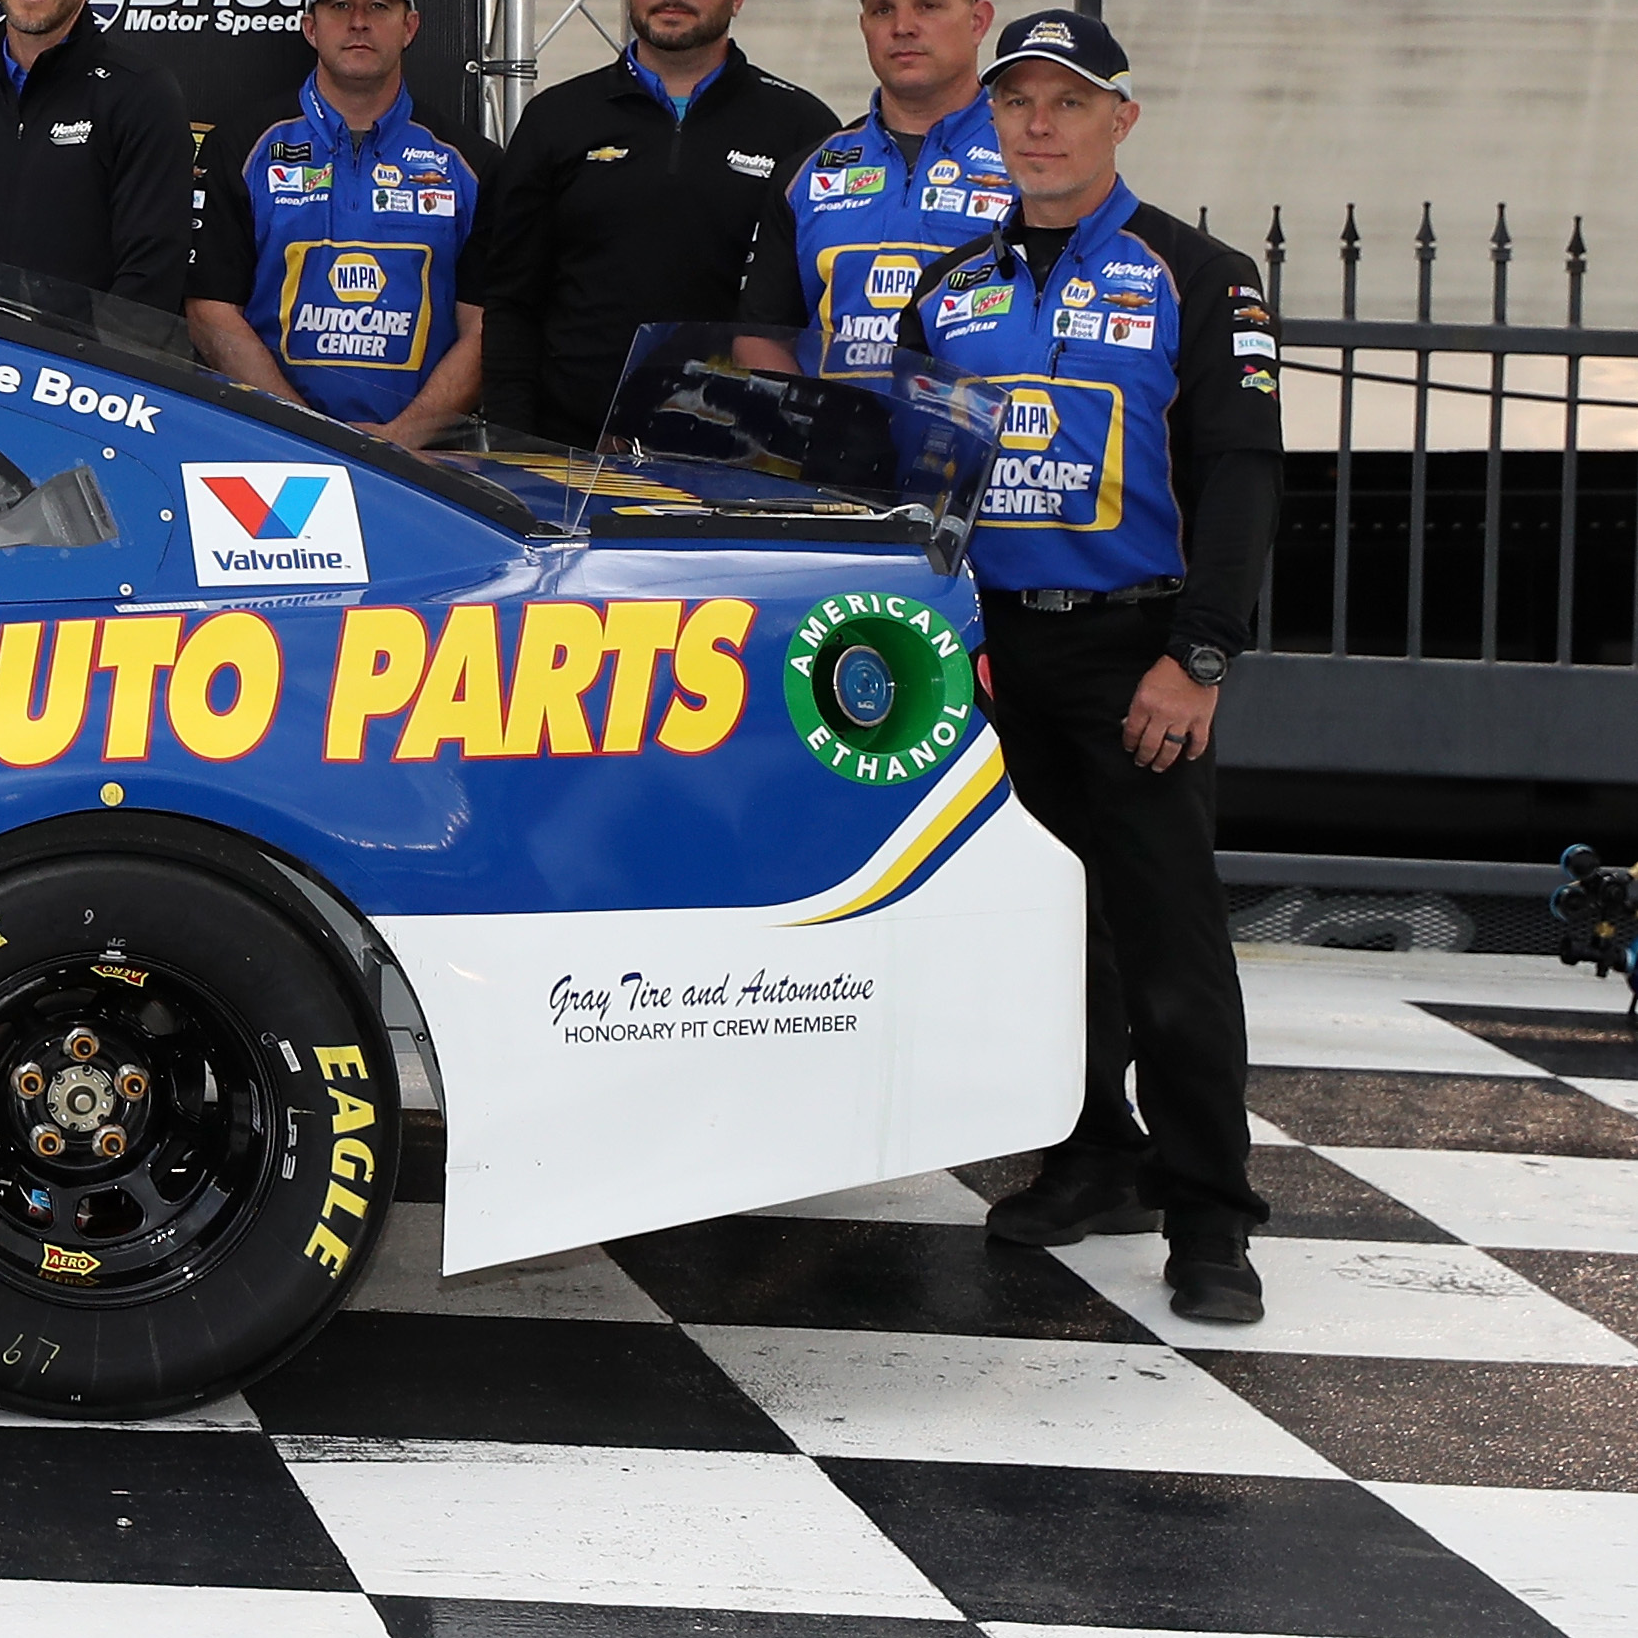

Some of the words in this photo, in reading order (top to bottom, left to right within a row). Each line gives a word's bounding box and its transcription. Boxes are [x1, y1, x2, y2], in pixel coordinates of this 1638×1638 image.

[123, 9, 209, 32] Motor
[51, 120, 94, 138] Hendrick
[727, 150, 776, 169] Hendrick
[336, 267, 378, 290] NAPA
[316, 333, 387, 357] CENTER
[31, 367, 162, 435] Book
[980, 488, 1063, 517] CENTER
[211, 547, 344, 573] Valvoline
[790, 594, 960, 678] AMERICAN
[322, 598, 757, 762] PARTS
[806, 703, 969, 781] ETHANOL
[102, 964, 141, 979] AERO
[548, 973, 613, 1026] Gray
[621, 971, 672, 1012] Tire
[681, 972, 731, 1008] and
[735, 967, 877, 1008] Automotive
[564, 1021, 677, 1045] HONORARY
[680, 1019, 709, 1040] PIT
[712, 1018, 770, 1038] CREW
[773, 1014, 858, 1036] MEMBER
[311, 1043, 375, 1281] EAGLE
[48, 1254, 89, 1270] AERO
